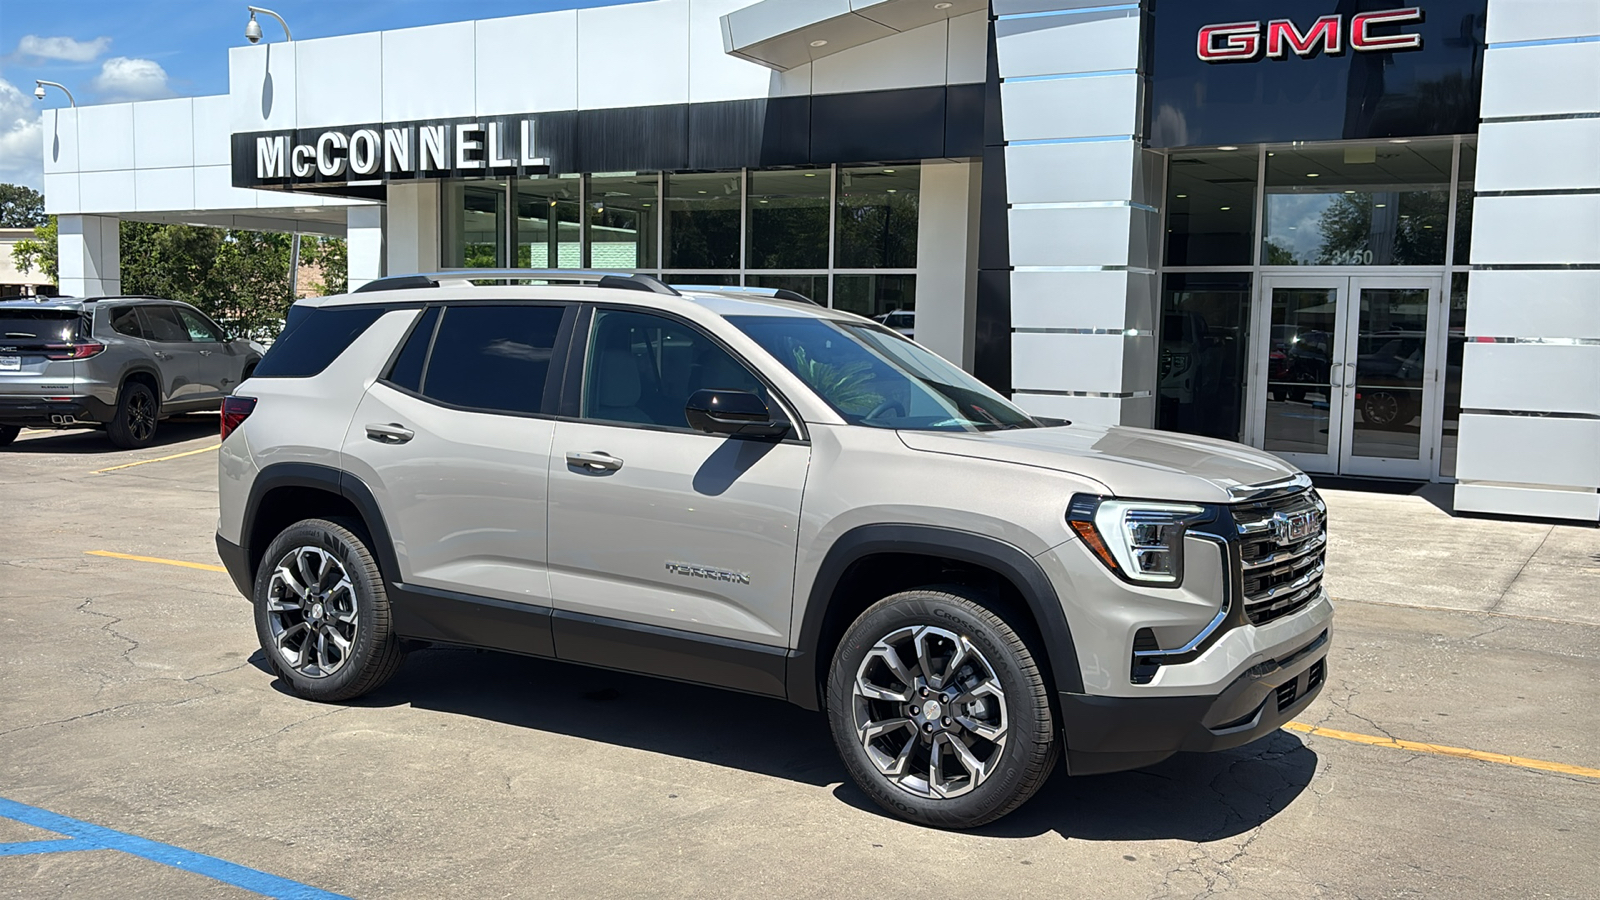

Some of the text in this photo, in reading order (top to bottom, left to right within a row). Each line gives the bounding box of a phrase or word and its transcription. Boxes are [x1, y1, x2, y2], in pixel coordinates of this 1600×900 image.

[1197, 7, 1421, 61] GMC
[256, 119, 550, 179] McCONNELL
[1288, 510, 1321, 540] GMC
[664, 561, 751, 585] TERRAIN
